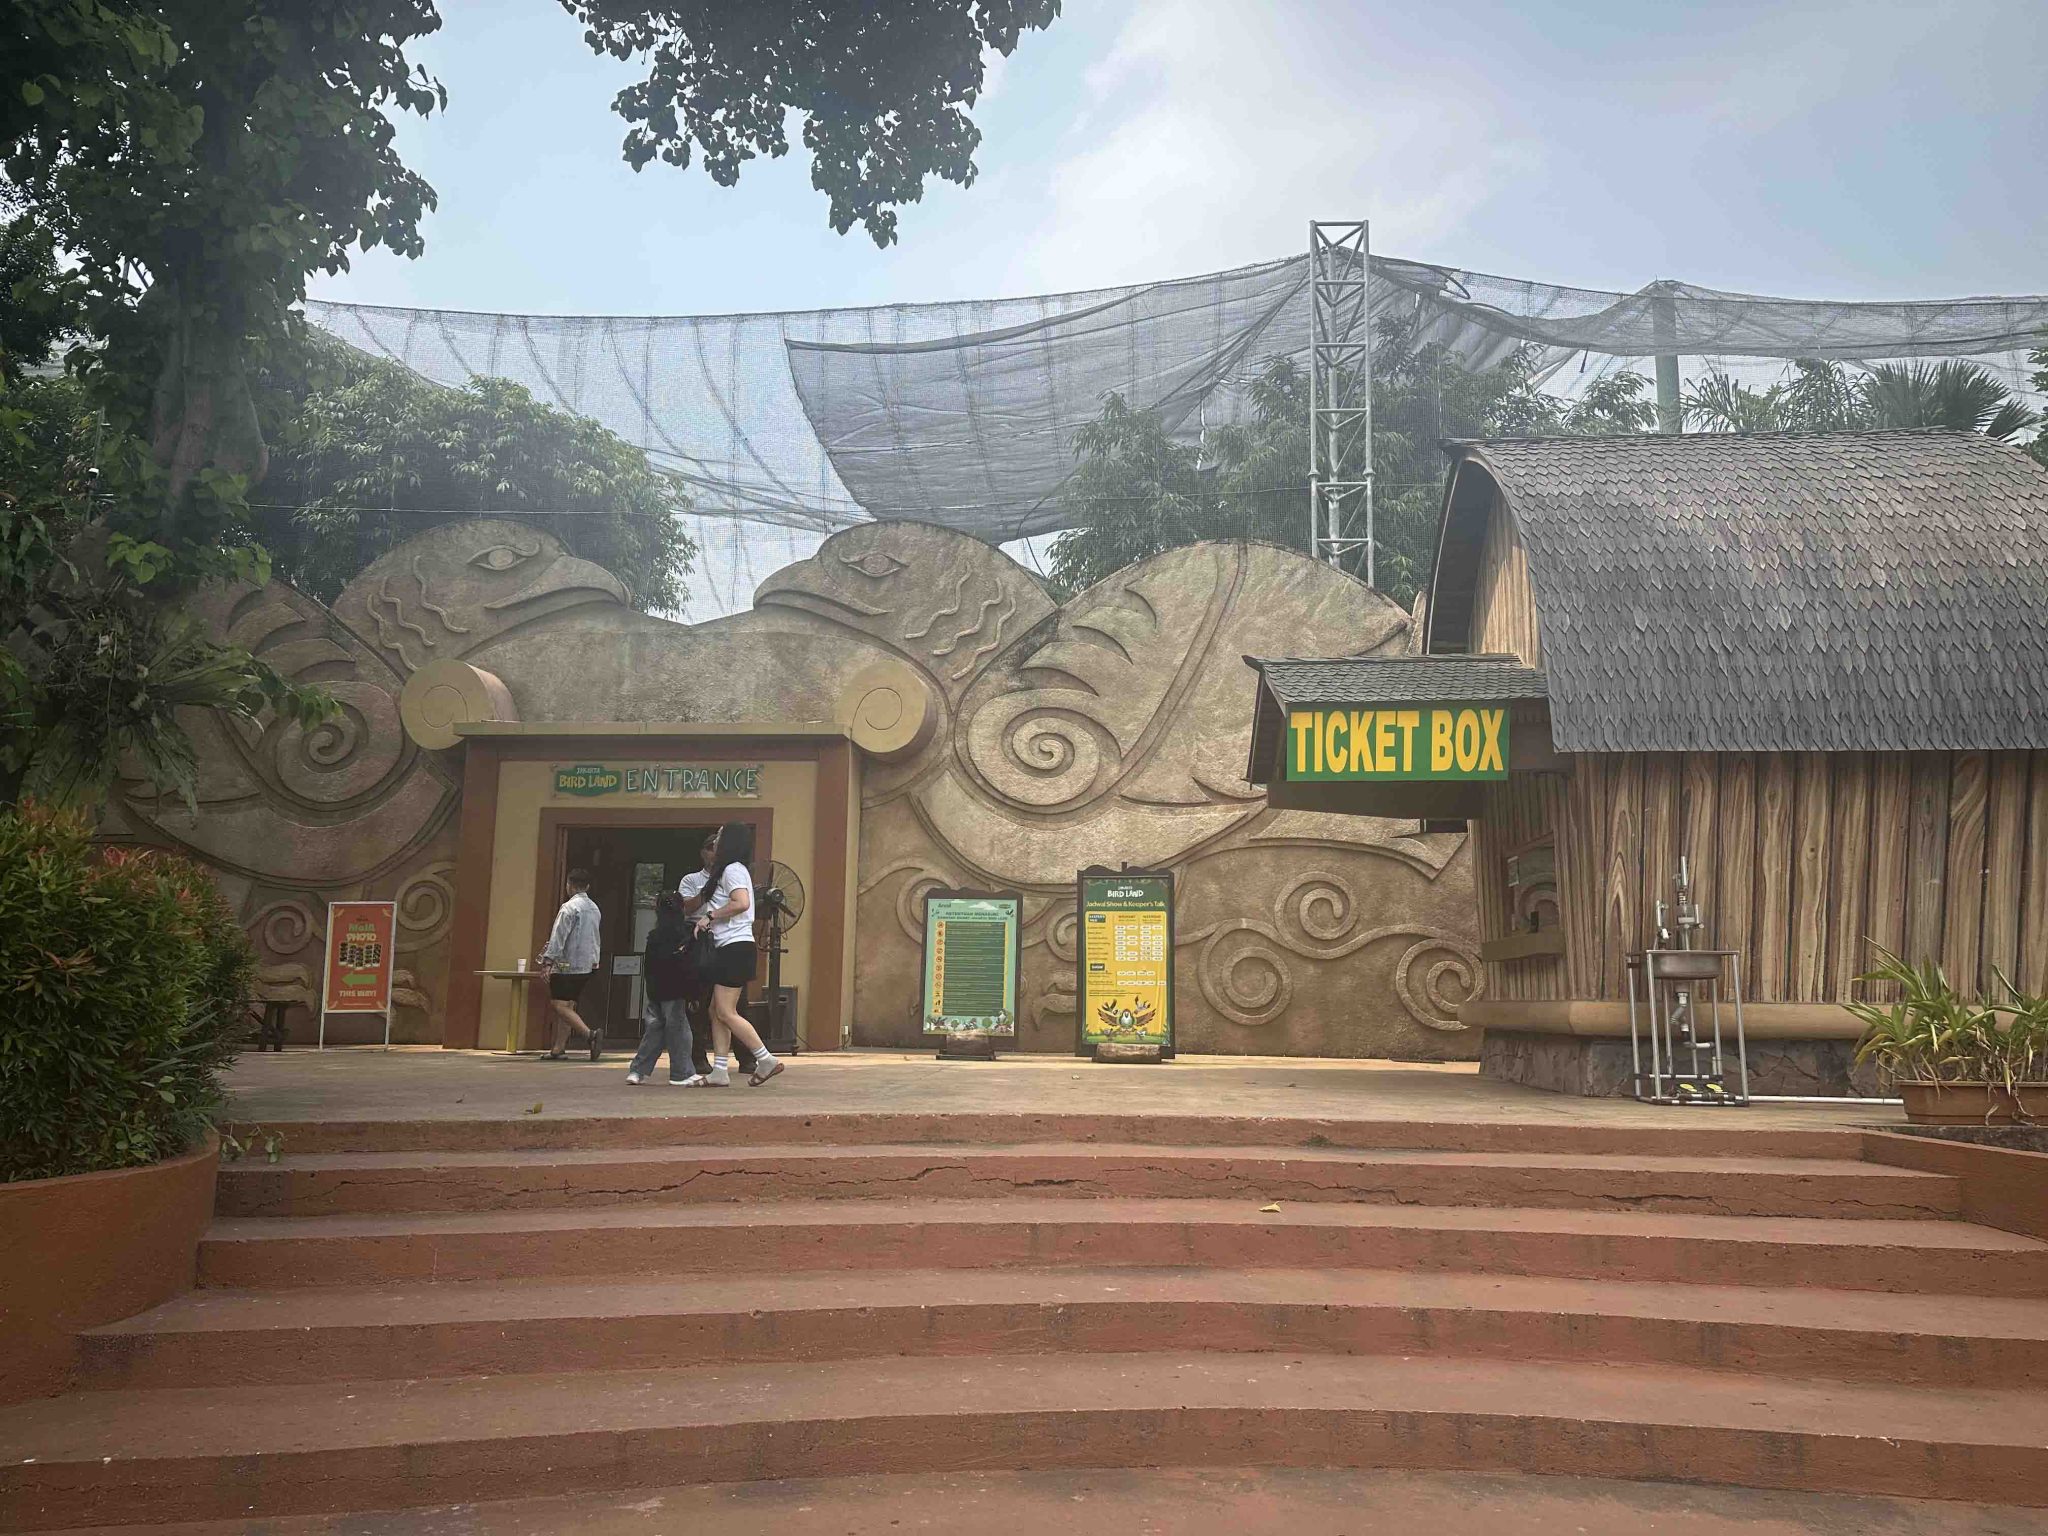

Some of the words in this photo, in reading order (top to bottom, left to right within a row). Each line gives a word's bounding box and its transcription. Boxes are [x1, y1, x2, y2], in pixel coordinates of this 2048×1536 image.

[1290, 710, 1420, 773] TICKET
[1431, 708, 1504, 772] BOX
[559, 774, 586, 789] BIRD
[588, 774, 617, 789] LAND
[626, 768, 758, 791] ENTRANCE
[1107, 889, 1124, 898] BIRD
[1125, 889, 1144, 898] LAND
